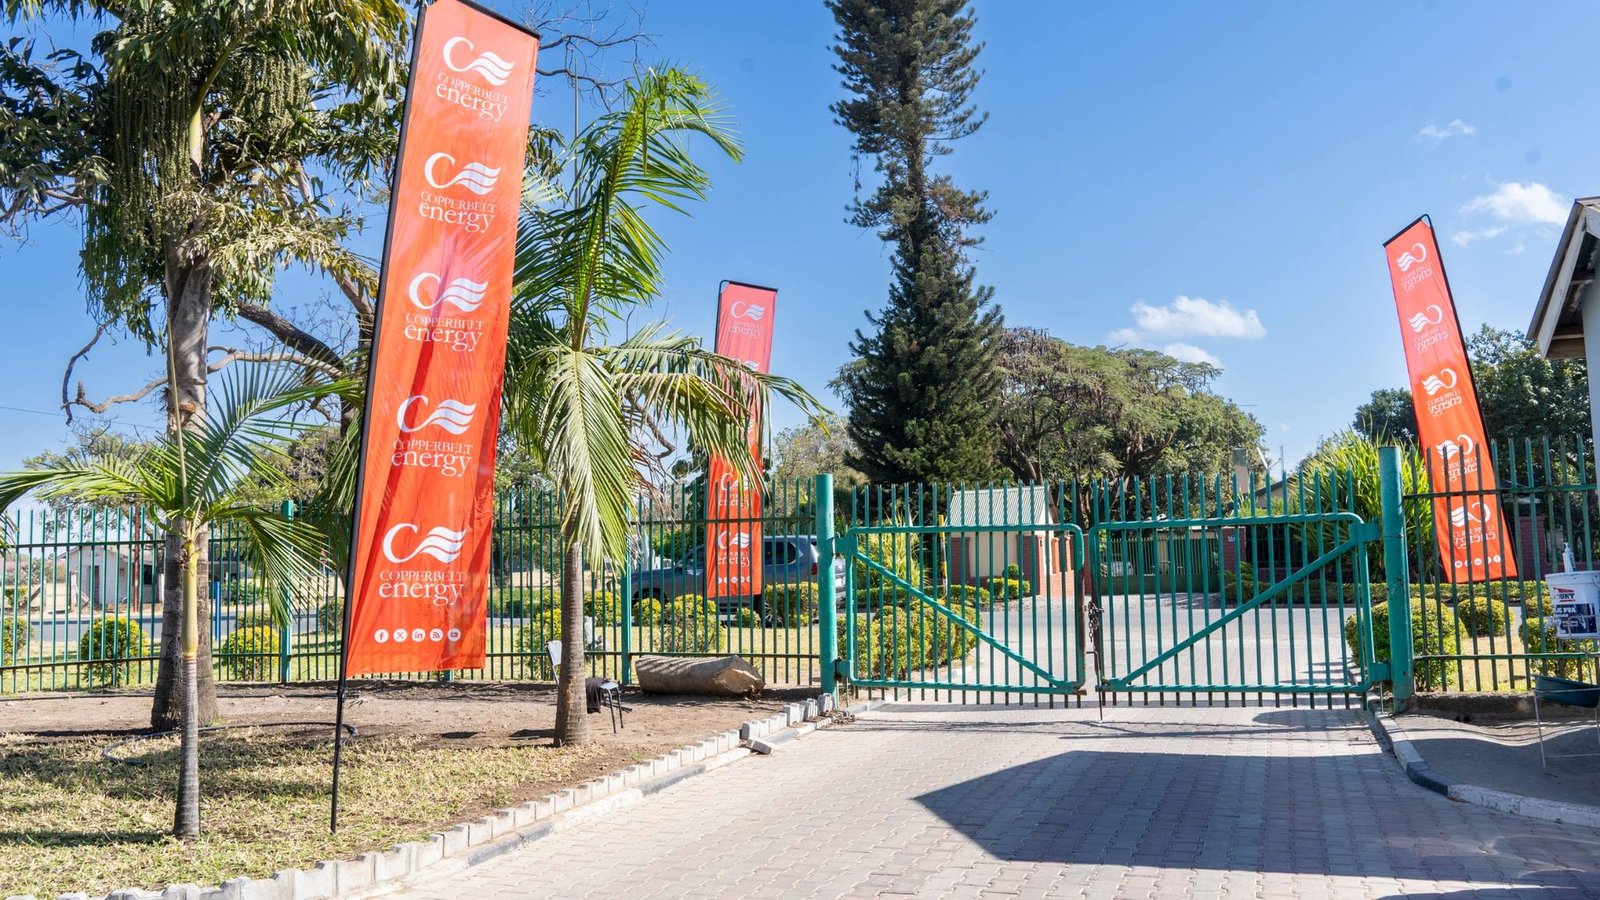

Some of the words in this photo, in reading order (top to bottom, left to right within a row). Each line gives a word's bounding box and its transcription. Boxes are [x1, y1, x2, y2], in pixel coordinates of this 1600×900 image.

[437, 72, 510, 104] COPPERBELT
[436, 82, 508, 122] energy
[420, 190, 496, 214] COPPERBELT
[418, 201, 496, 233] energy
[405, 312, 485, 330] COPPERBELT
[403, 323, 483, 352] energy
[393, 439, 473, 455] COPPERBELT
[391, 450, 472, 477] energy
[379, 569, 465, 582] COPPERBELT
[378, 580, 465, 607] energy
